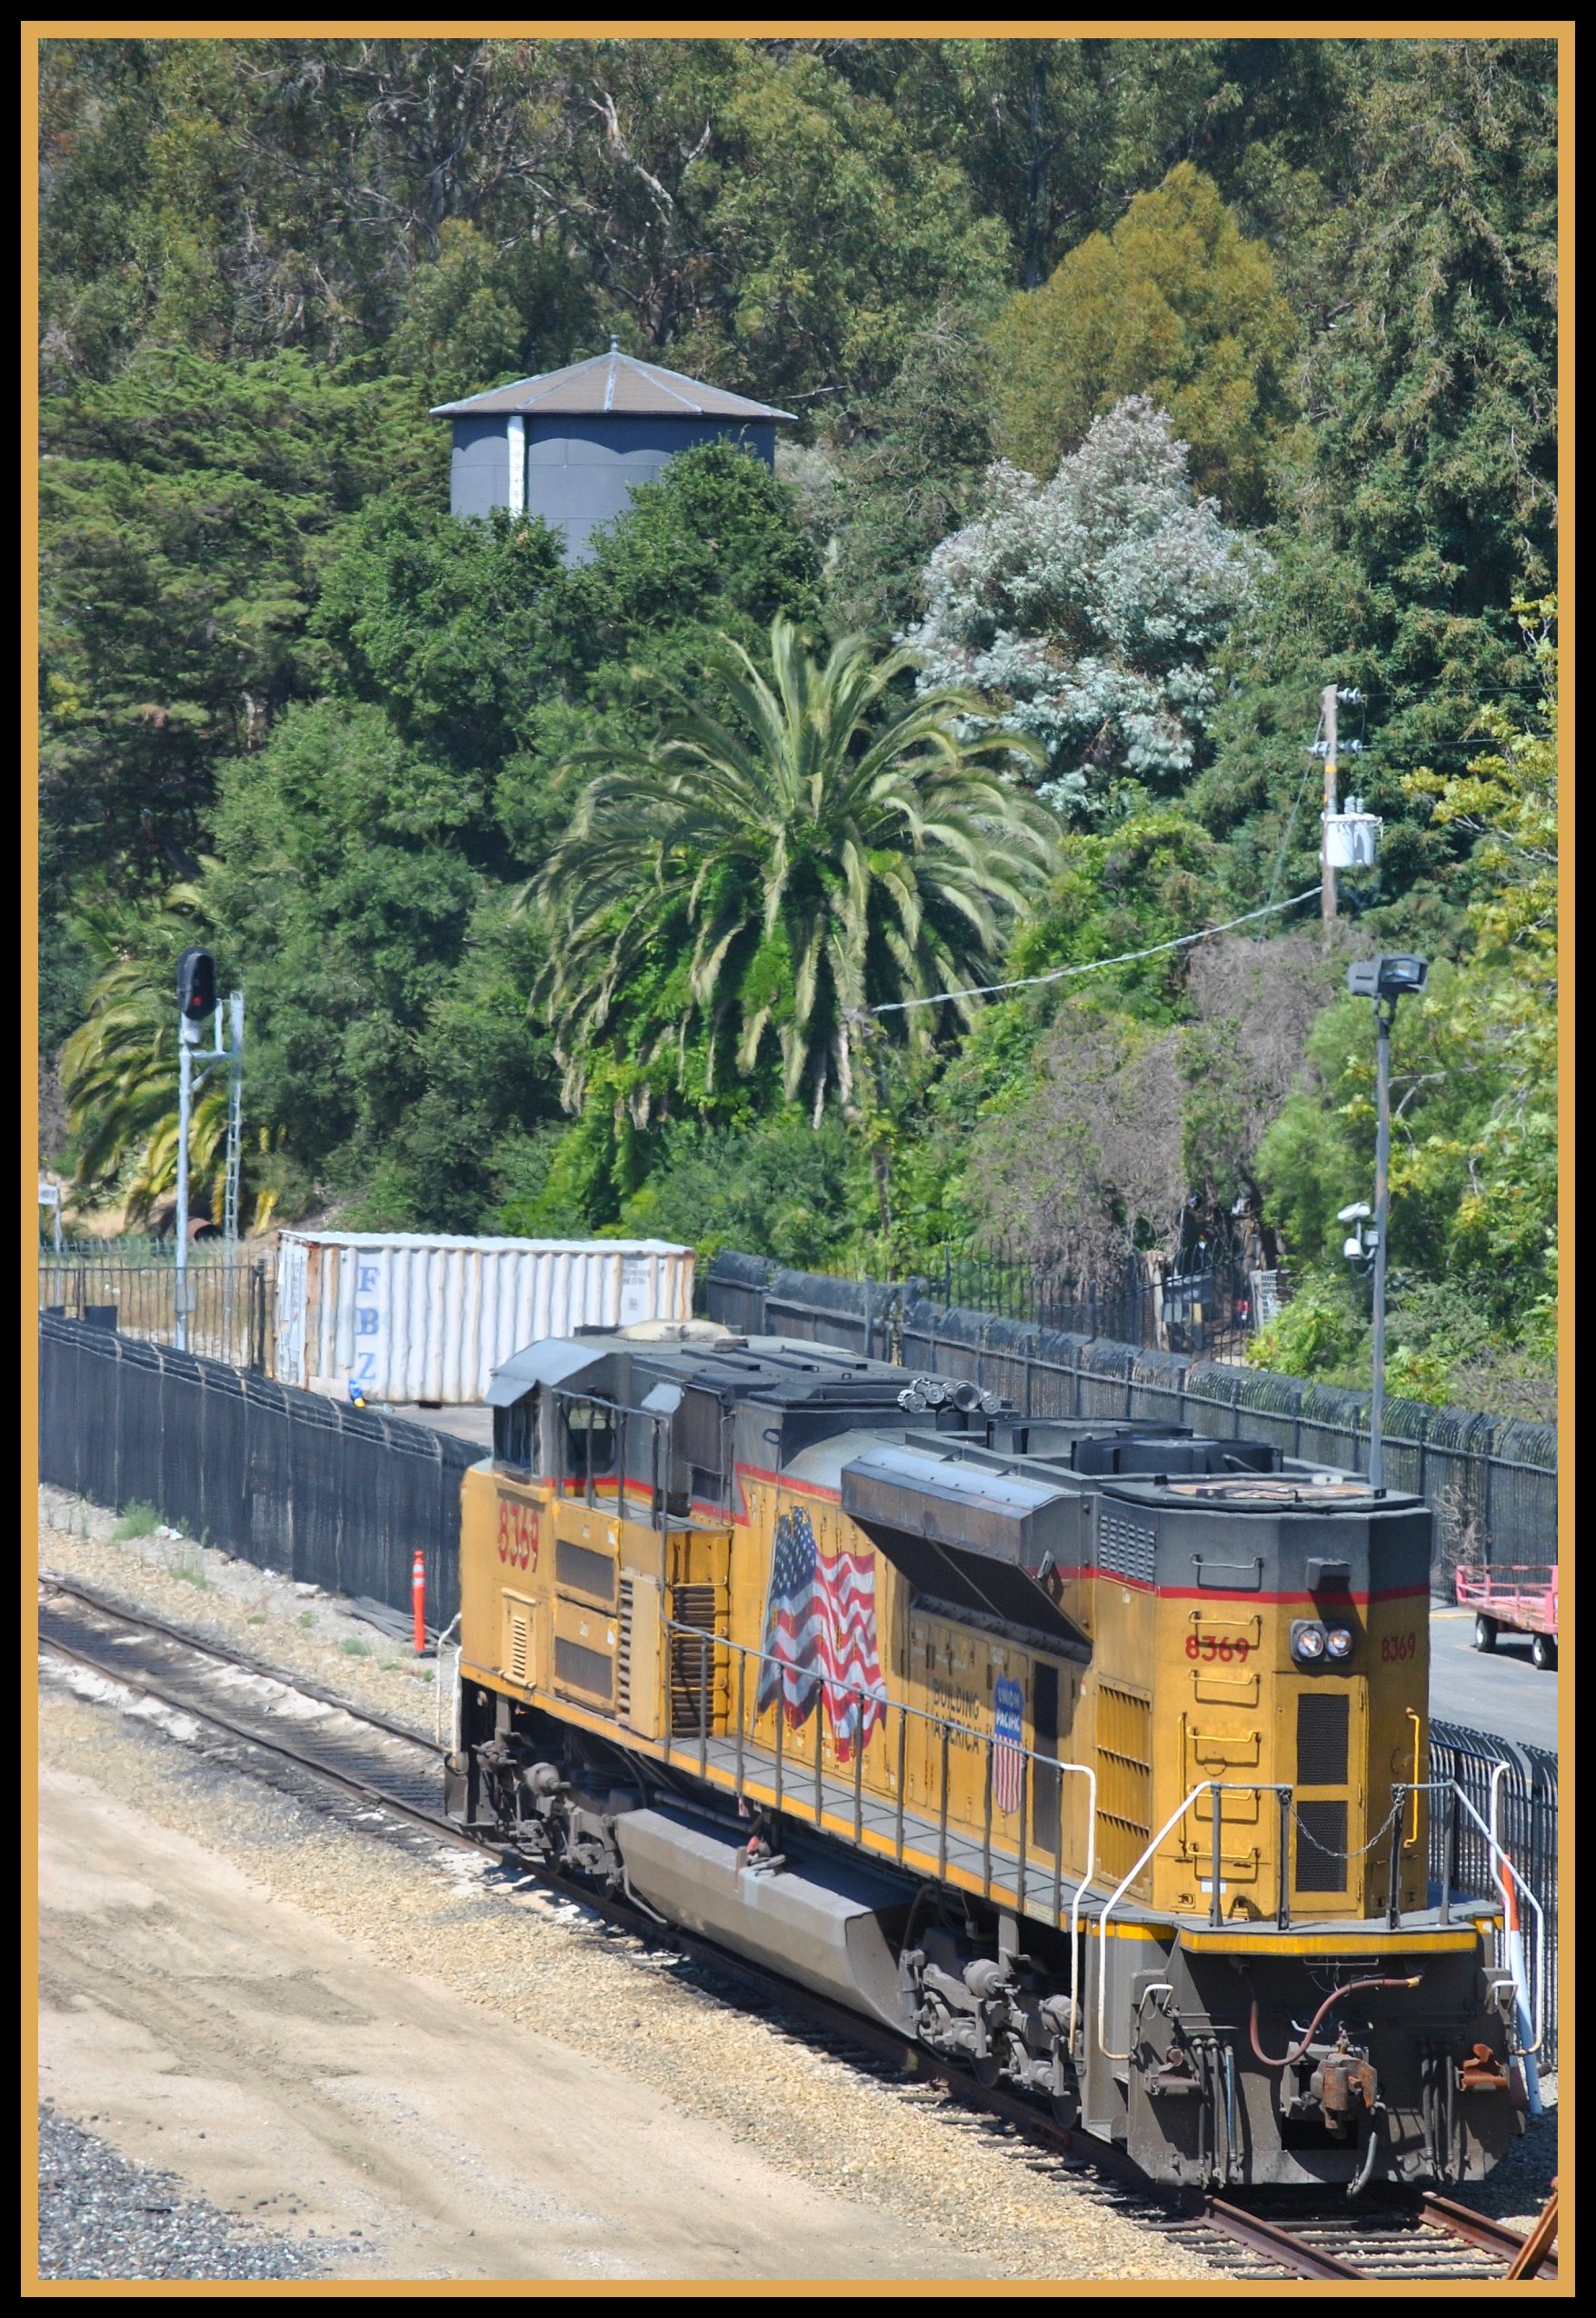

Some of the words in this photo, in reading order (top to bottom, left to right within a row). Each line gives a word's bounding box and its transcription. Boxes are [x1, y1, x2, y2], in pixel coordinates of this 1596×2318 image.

[498, 1500, 539, 1574] 8369
[1185, 1634, 1250, 1663] 8369
[1382, 1633, 1416, 1663] 8369
[932, 1678, 979, 1721] BUILDING
[997, 1686, 1021, 1708] UNION
